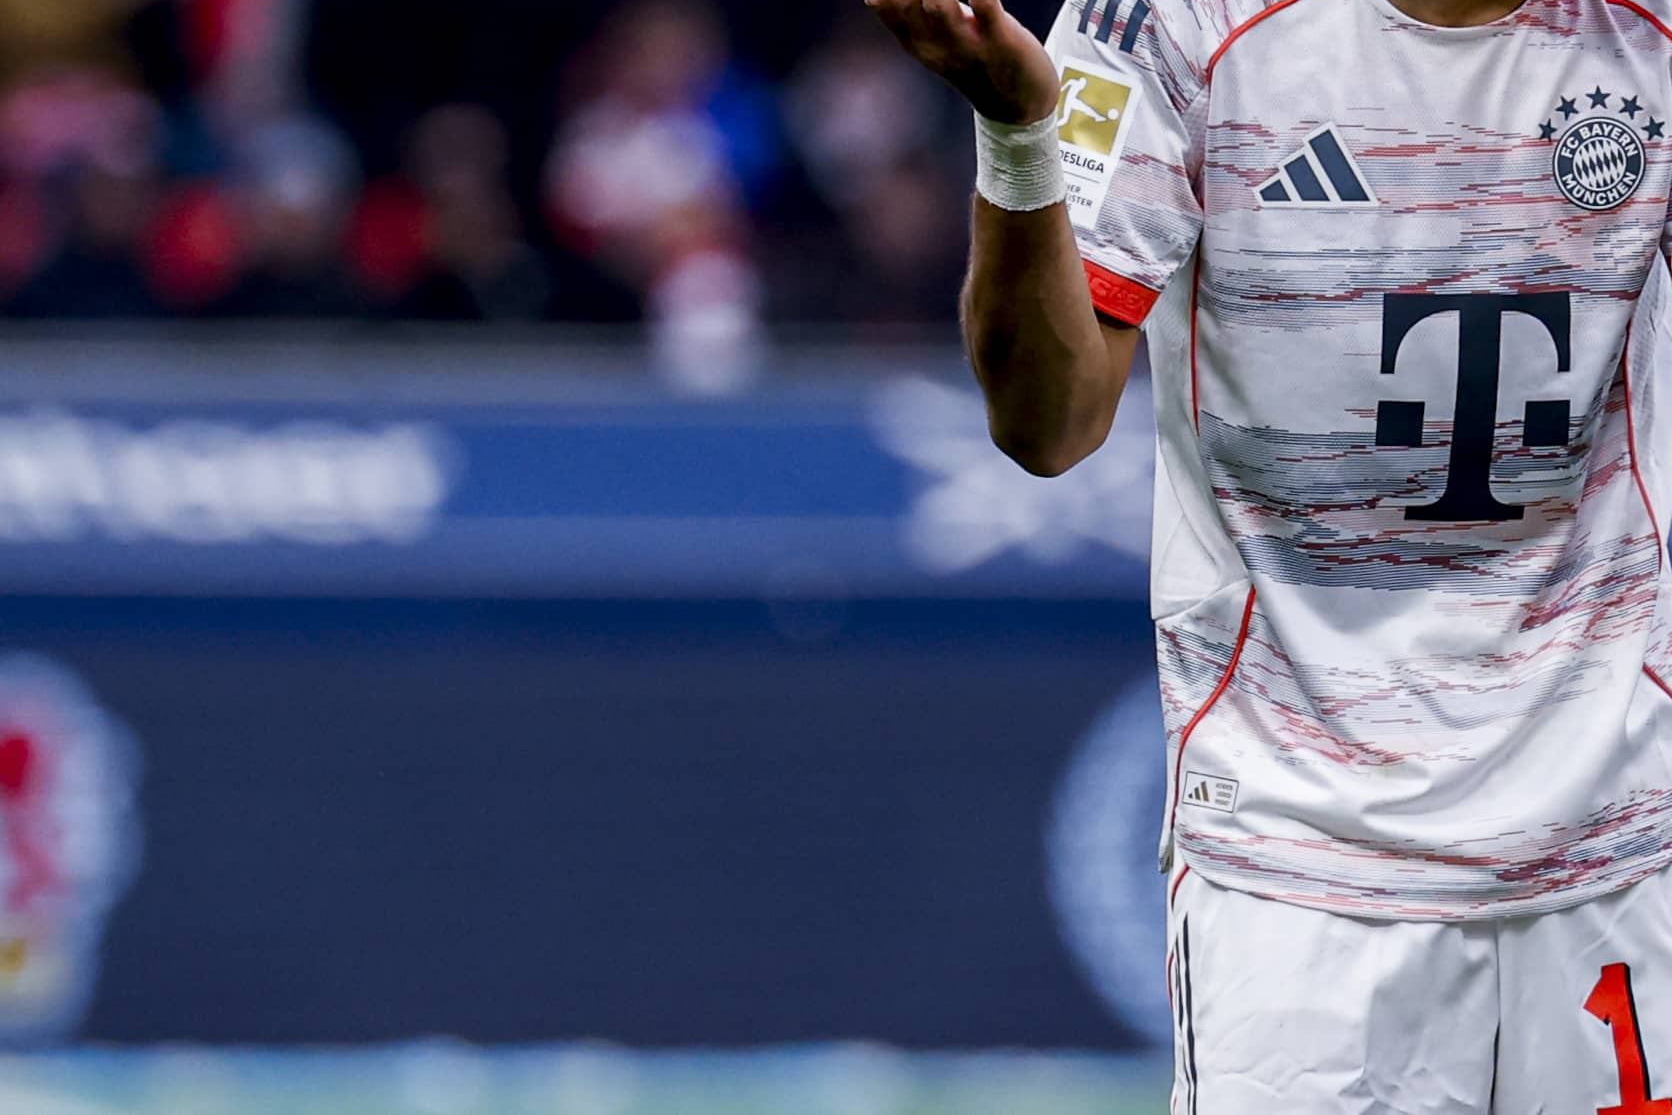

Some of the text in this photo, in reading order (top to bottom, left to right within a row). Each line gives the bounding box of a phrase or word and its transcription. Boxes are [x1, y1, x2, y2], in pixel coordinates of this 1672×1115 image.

[1561, 123, 1639, 158] FC BAYERN
[1375, 290, 1572, 522] T
